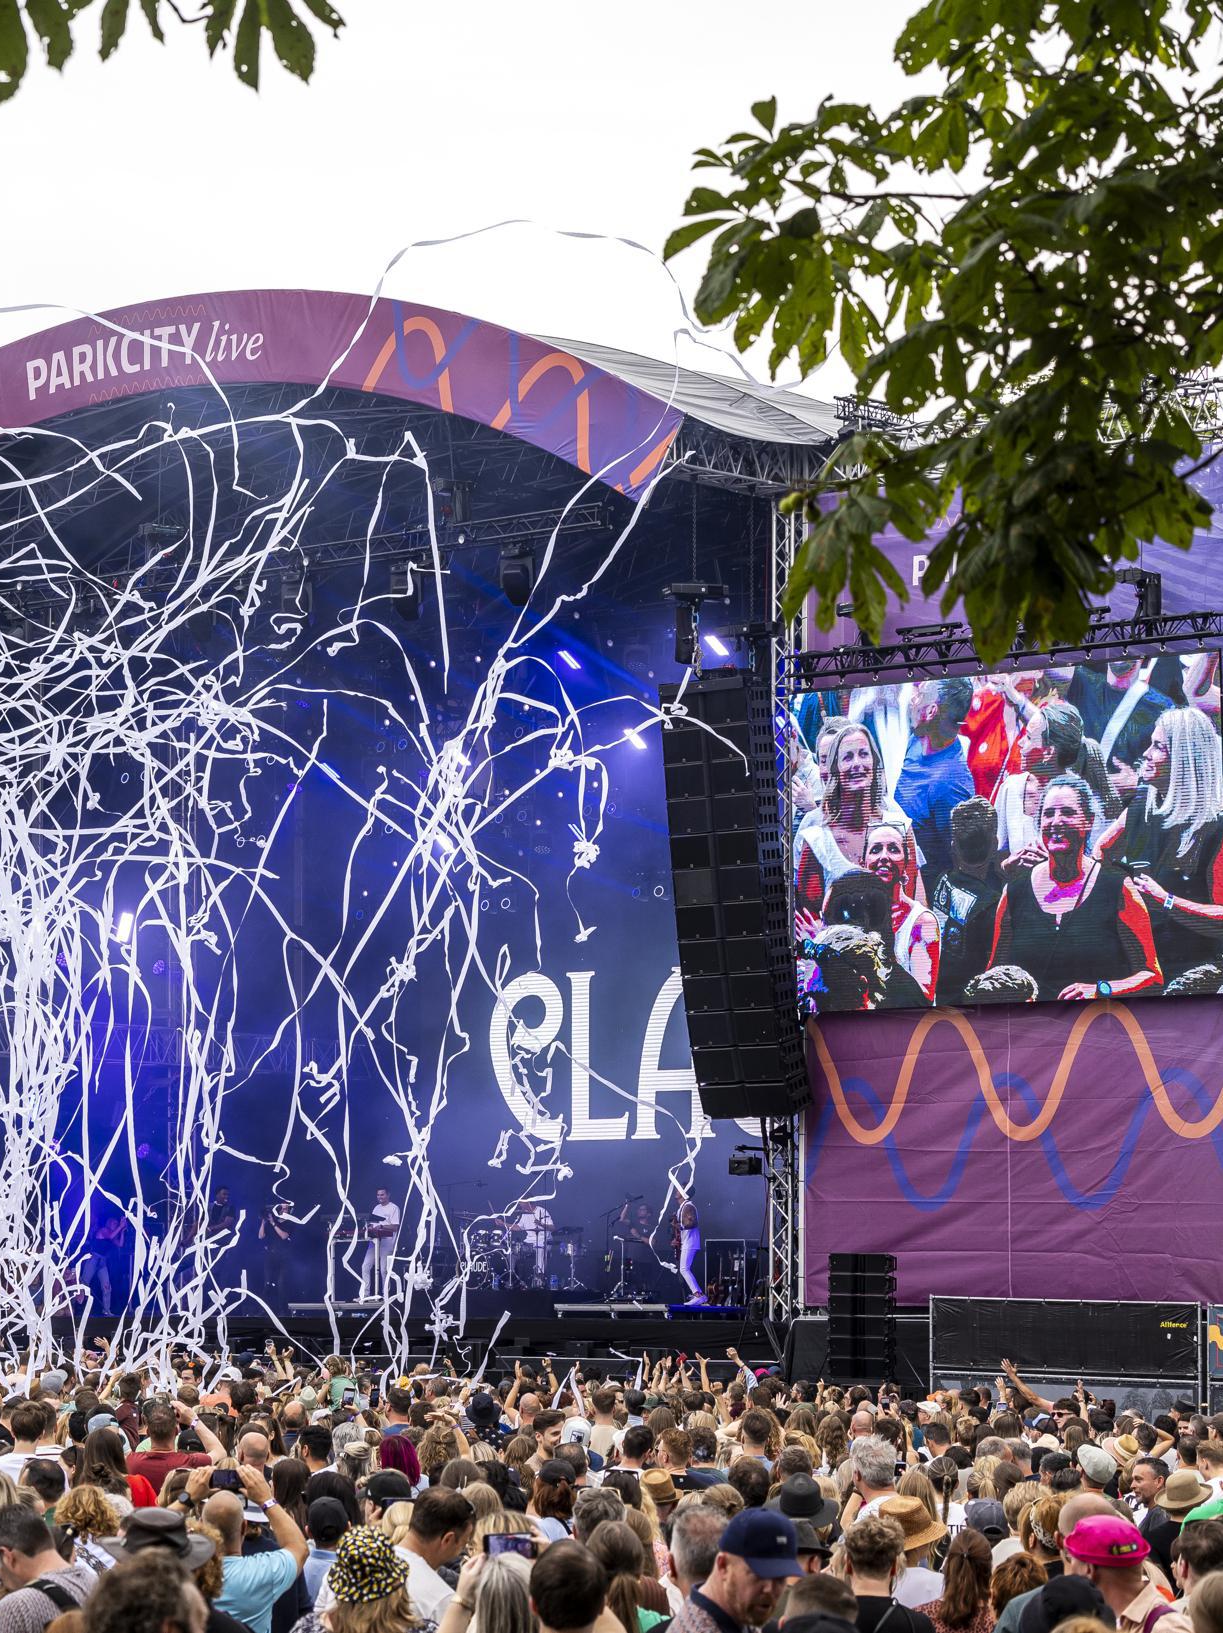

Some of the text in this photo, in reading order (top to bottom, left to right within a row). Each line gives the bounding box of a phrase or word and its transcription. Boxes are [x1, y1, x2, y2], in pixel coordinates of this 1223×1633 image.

[26, 320, 265, 401] PARKCITY live
[490, 967, 774, 1141] CLA
